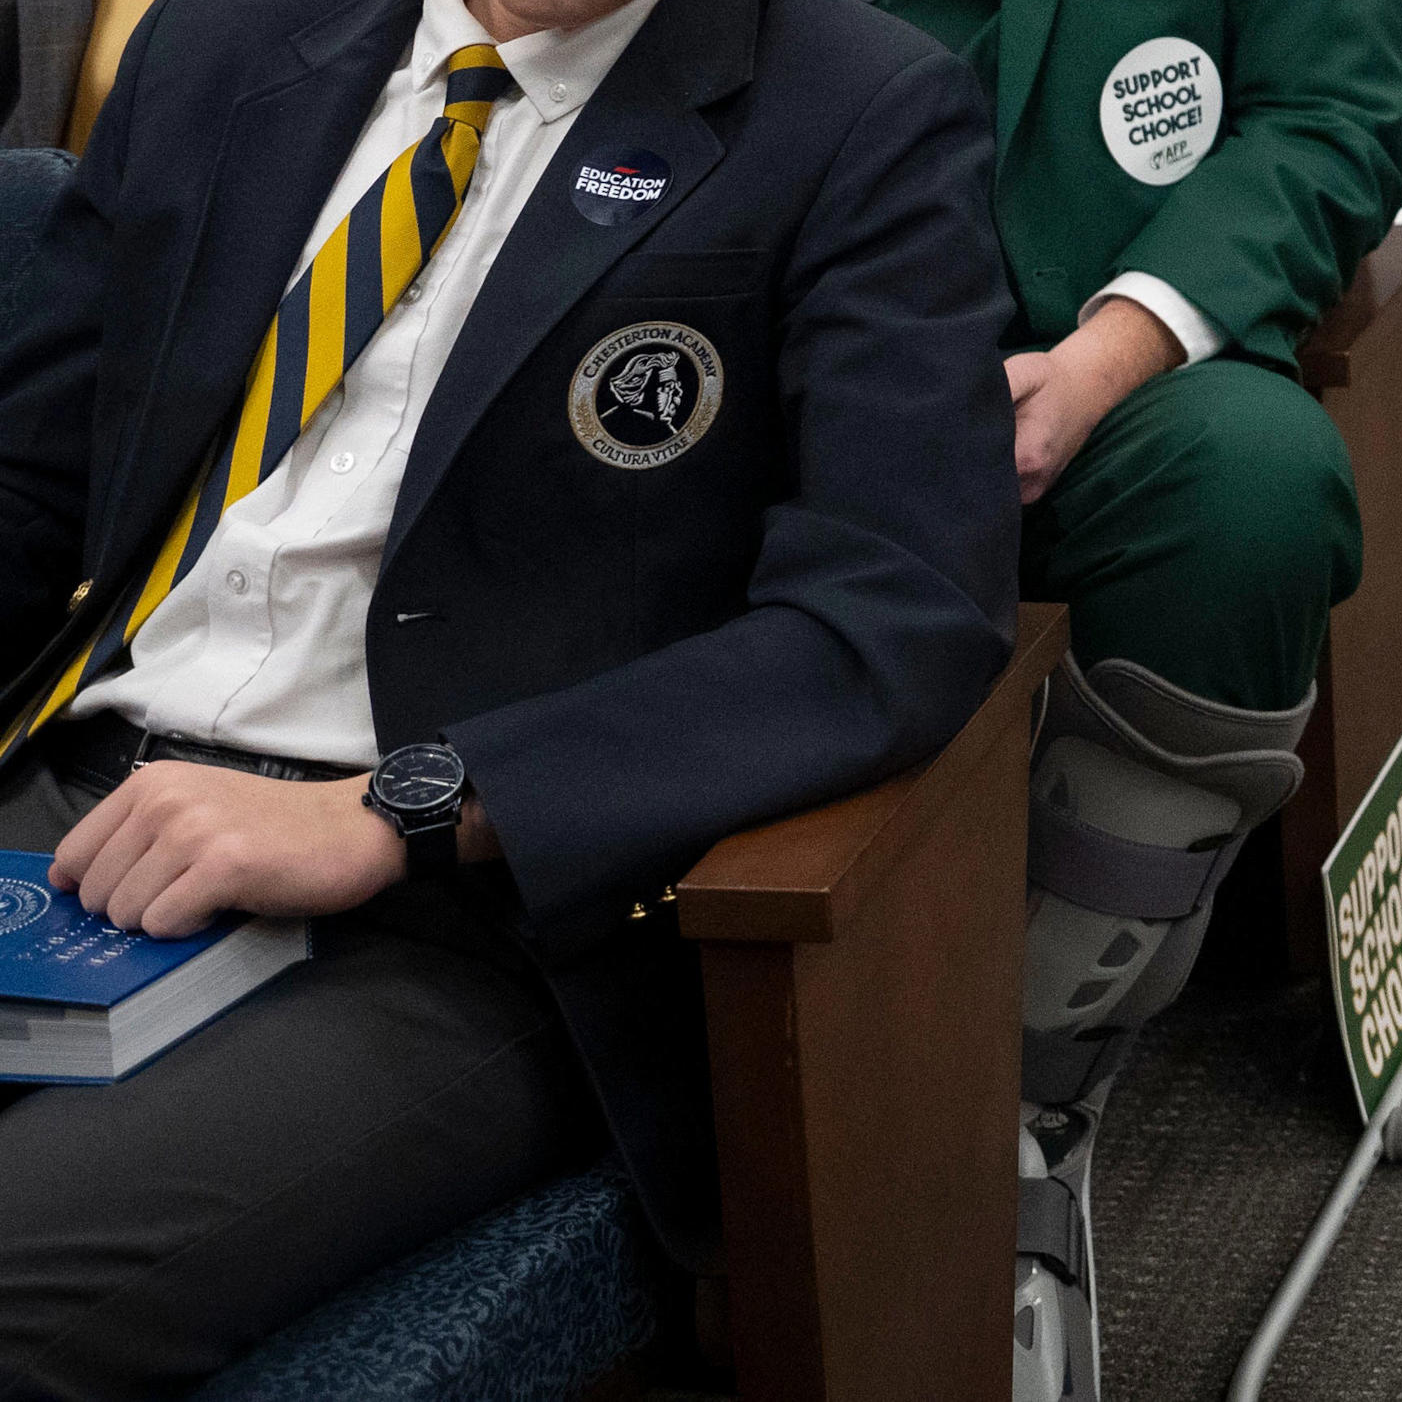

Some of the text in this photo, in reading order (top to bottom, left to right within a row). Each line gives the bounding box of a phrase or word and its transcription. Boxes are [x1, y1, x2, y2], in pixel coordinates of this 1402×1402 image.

[1113, 56, 1201, 99] SUPPORT
[1122, 83, 1202, 123] SCHOOL
[1128, 106, 1202, 145] CHOICE!
[575, 177, 662, 202] FREEDOM
[580, 166, 666, 190] EDUCATION
[583, 328, 717, 379] CHESTERTON ACADEMY
[592, 439, 650, 466] CULTURA
